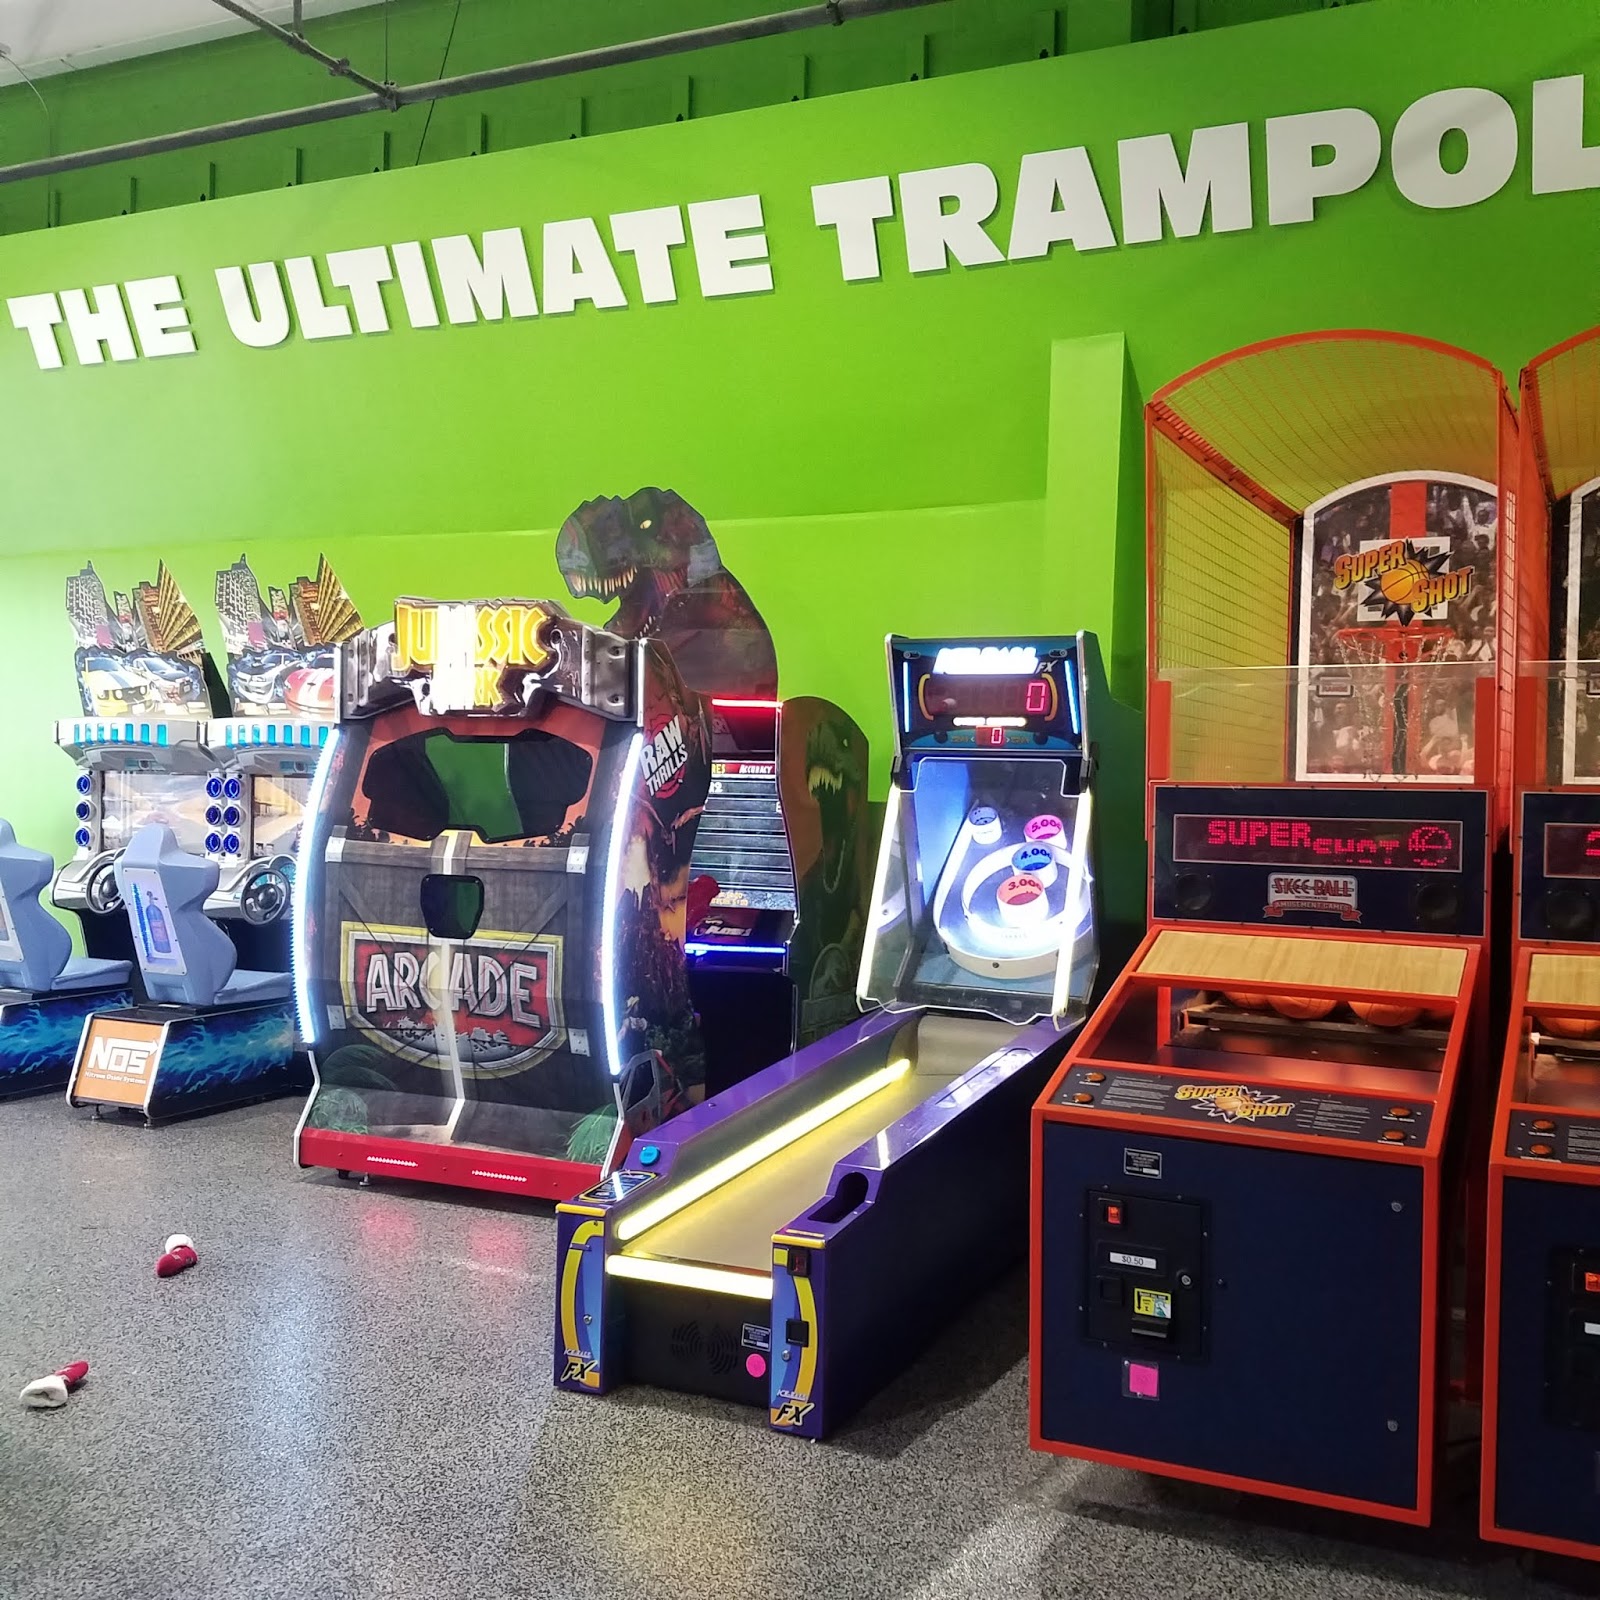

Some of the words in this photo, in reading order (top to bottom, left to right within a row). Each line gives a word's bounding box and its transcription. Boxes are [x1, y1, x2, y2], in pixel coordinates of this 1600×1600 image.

[5, 274, 198, 370] THE
[213, 194, 775, 350] ULTIMATE
[810, 73, 1600, 283] TRAMPOL
[1334, 540, 1407, 590] SUPER
[1411, 565, 1475, 614] SHOT
[1035, 660, 1058, 675] FX
[1026, 682, 1046, 712] 0
[640, 715, 683, 780] RAW
[991, 727, 1002, 744] 0
[646, 743, 688, 797] THRILLS
[739, 764, 773, 774] ACCURACY
[1208, 820, 1311, 848] SUPER
[1275, 901, 1320, 909] AMUSEMENT
[1323, 904, 1350, 912] GAMES
[366, 951, 541, 1028] ARCADE
[87, 1036, 158, 1075] NOS
[1174, 1085, 1241, 1100] SUPER
[1236, 1102, 1295, 1117] SHOT
[1121, 1255, 1144, 1266] $0.50
[560, 1360, 598, 1382] FX
[774, 1403, 815, 1425] FX
